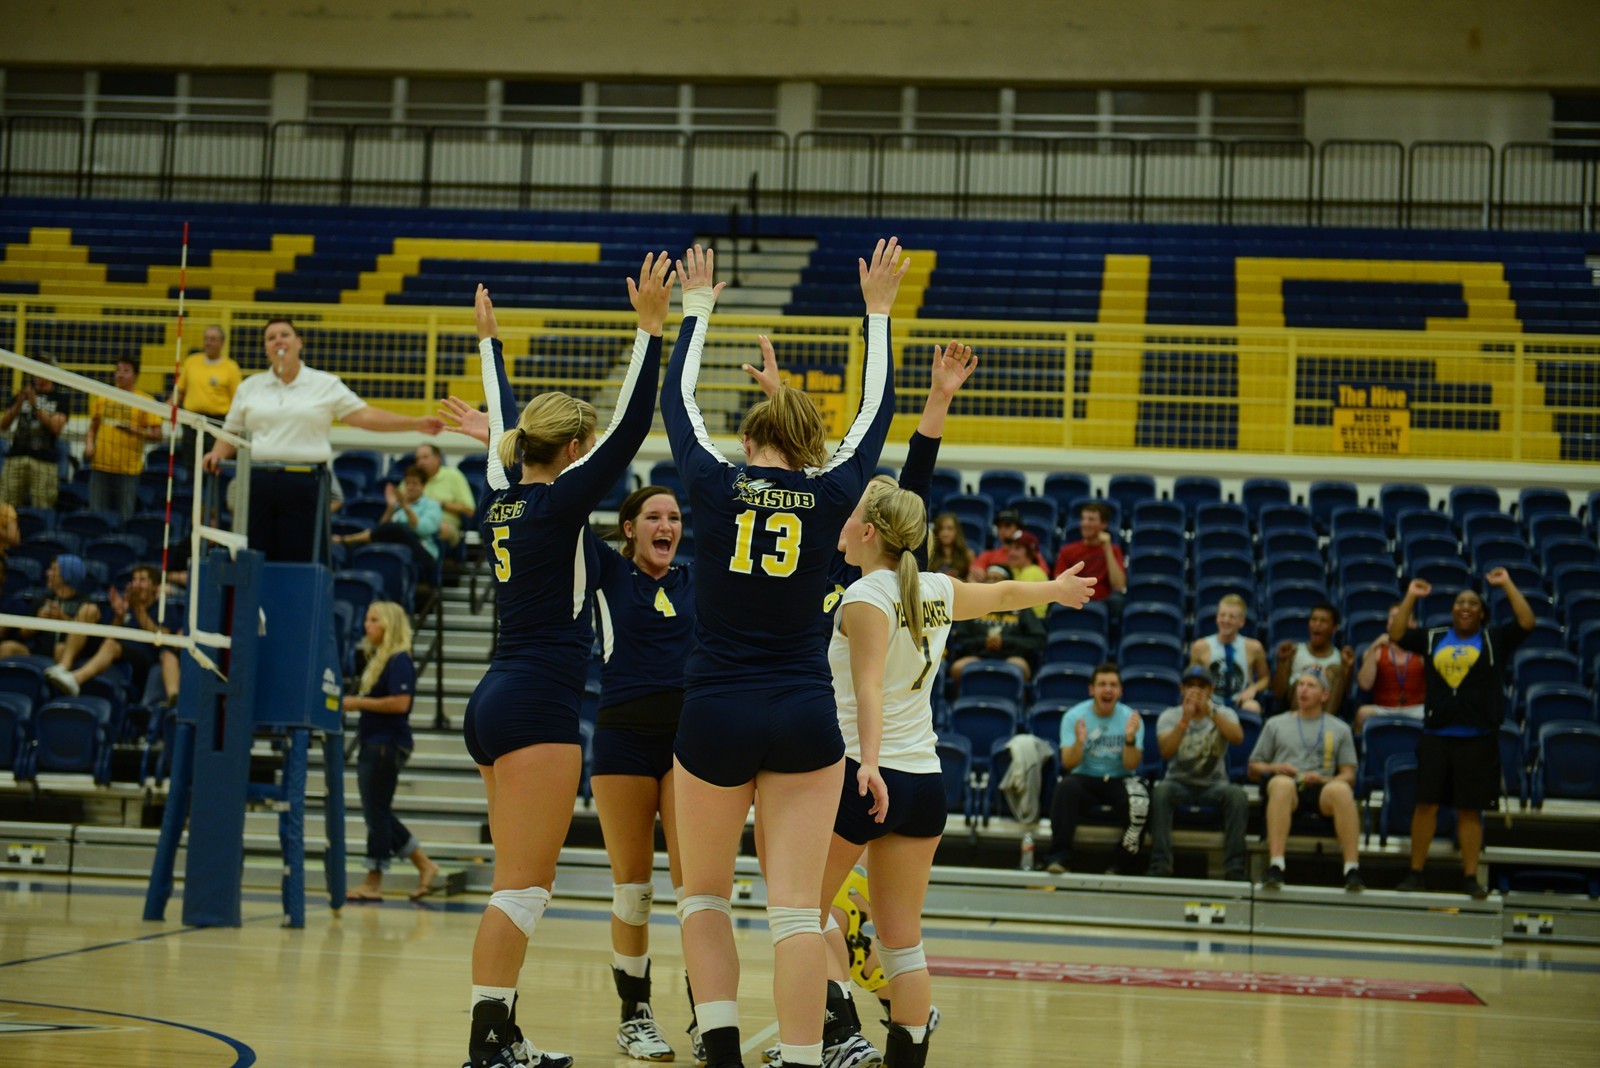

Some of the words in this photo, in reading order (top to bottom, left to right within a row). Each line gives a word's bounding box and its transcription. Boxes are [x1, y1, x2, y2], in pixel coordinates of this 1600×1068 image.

[1338, 384, 1367, 407] The
[1370, 384, 1407, 408] Hive
[1341, 426, 1402, 438] STUDENT
[1343, 440, 1400, 453] SECTION
[745, 488, 815, 510] MSUB
[491, 525, 511, 583] 5
[729, 509, 803, 578] 13
[654, 586, 677, 617] 4
